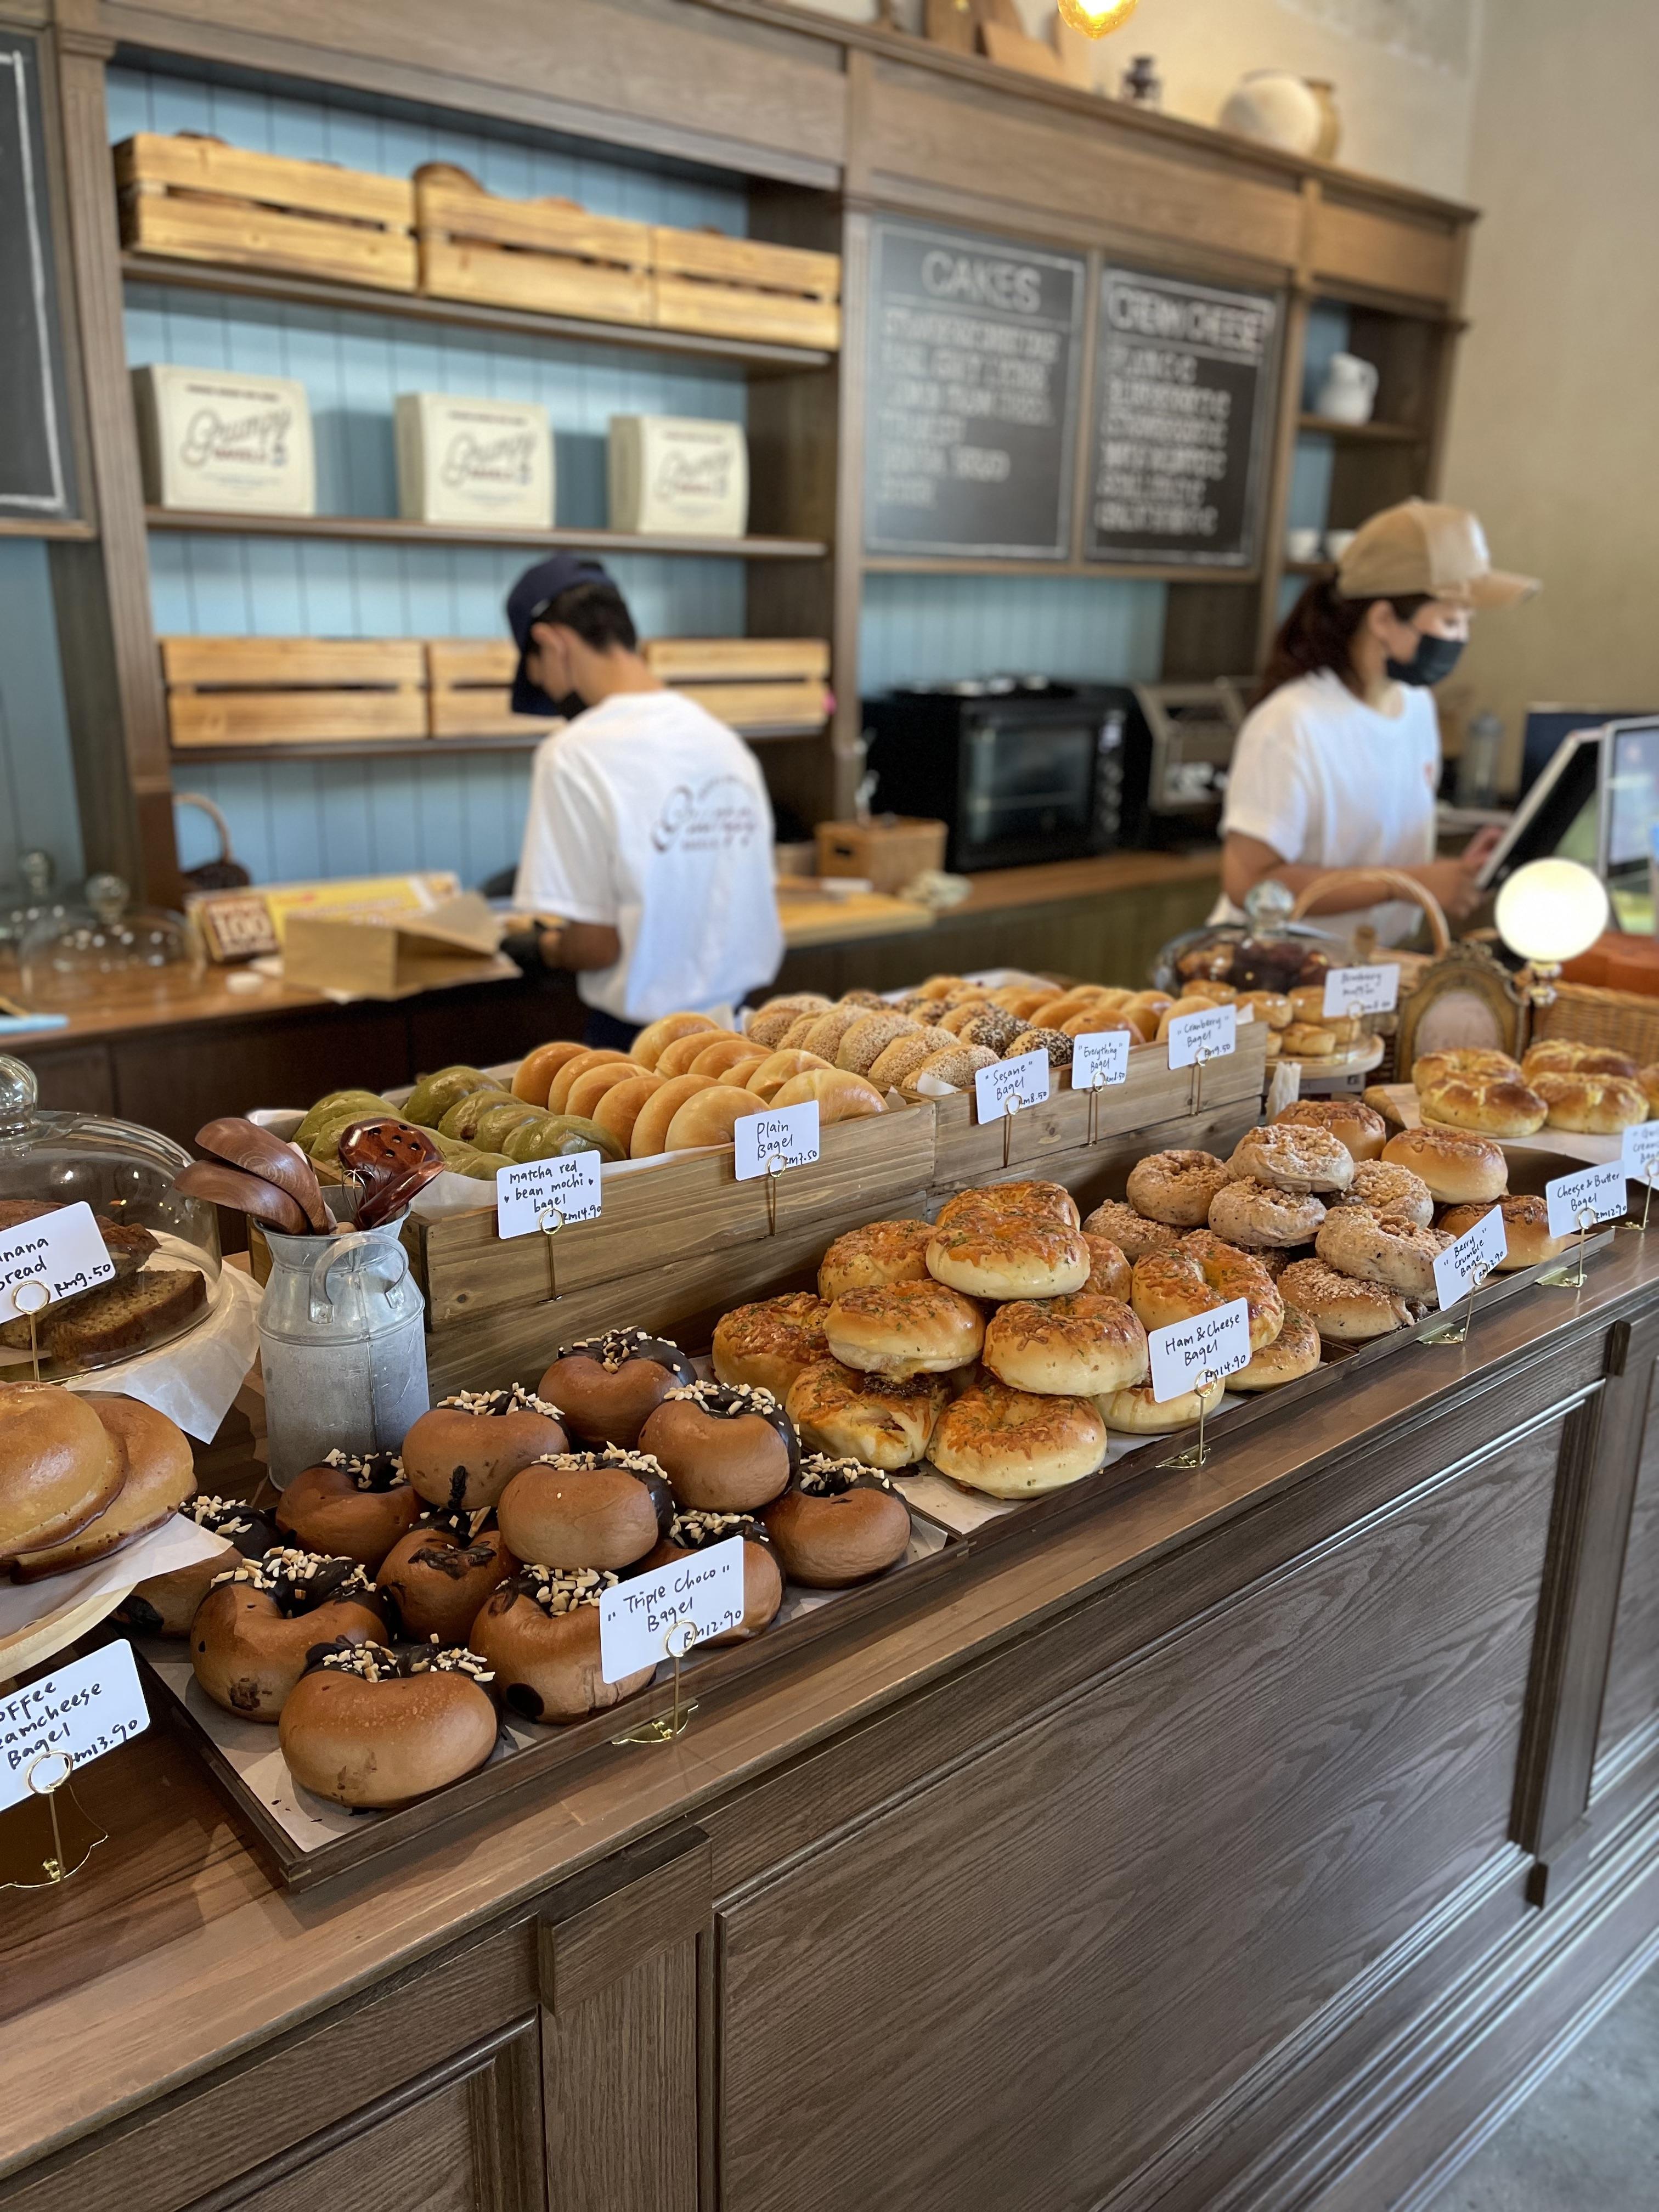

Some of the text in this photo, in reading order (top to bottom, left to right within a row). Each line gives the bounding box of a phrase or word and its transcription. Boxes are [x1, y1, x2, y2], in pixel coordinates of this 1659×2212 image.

[922, 250, 1041, 313] CAKES
[1187, 1030, 1211, 1047] Bagel
[1090, 1058, 1109, 1074] Bagel
[997, 1076, 1024, 1101] Bagel
[757, 1120, 788, 1144] Plain
[758, 1134, 793, 1159] Bagel
[510, 1160, 577, 1184] matcha red
[516, 1172, 583, 1200] bean mochi
[1557, 1173, 1620, 1198] Cheese & Butter
[534, 1193, 566, 1217] bagel
[1571, 1193, 1597, 1211] Bagel
[1460, 1251, 1484, 1277] Bagel
[1165, 1314, 1240, 1355] Ham & Cheese
[1184, 1339, 1217, 1366] Bagel
[648, 1596, 693, 1632] Bagel
[7, 1722, 70, 1770] Bagel
